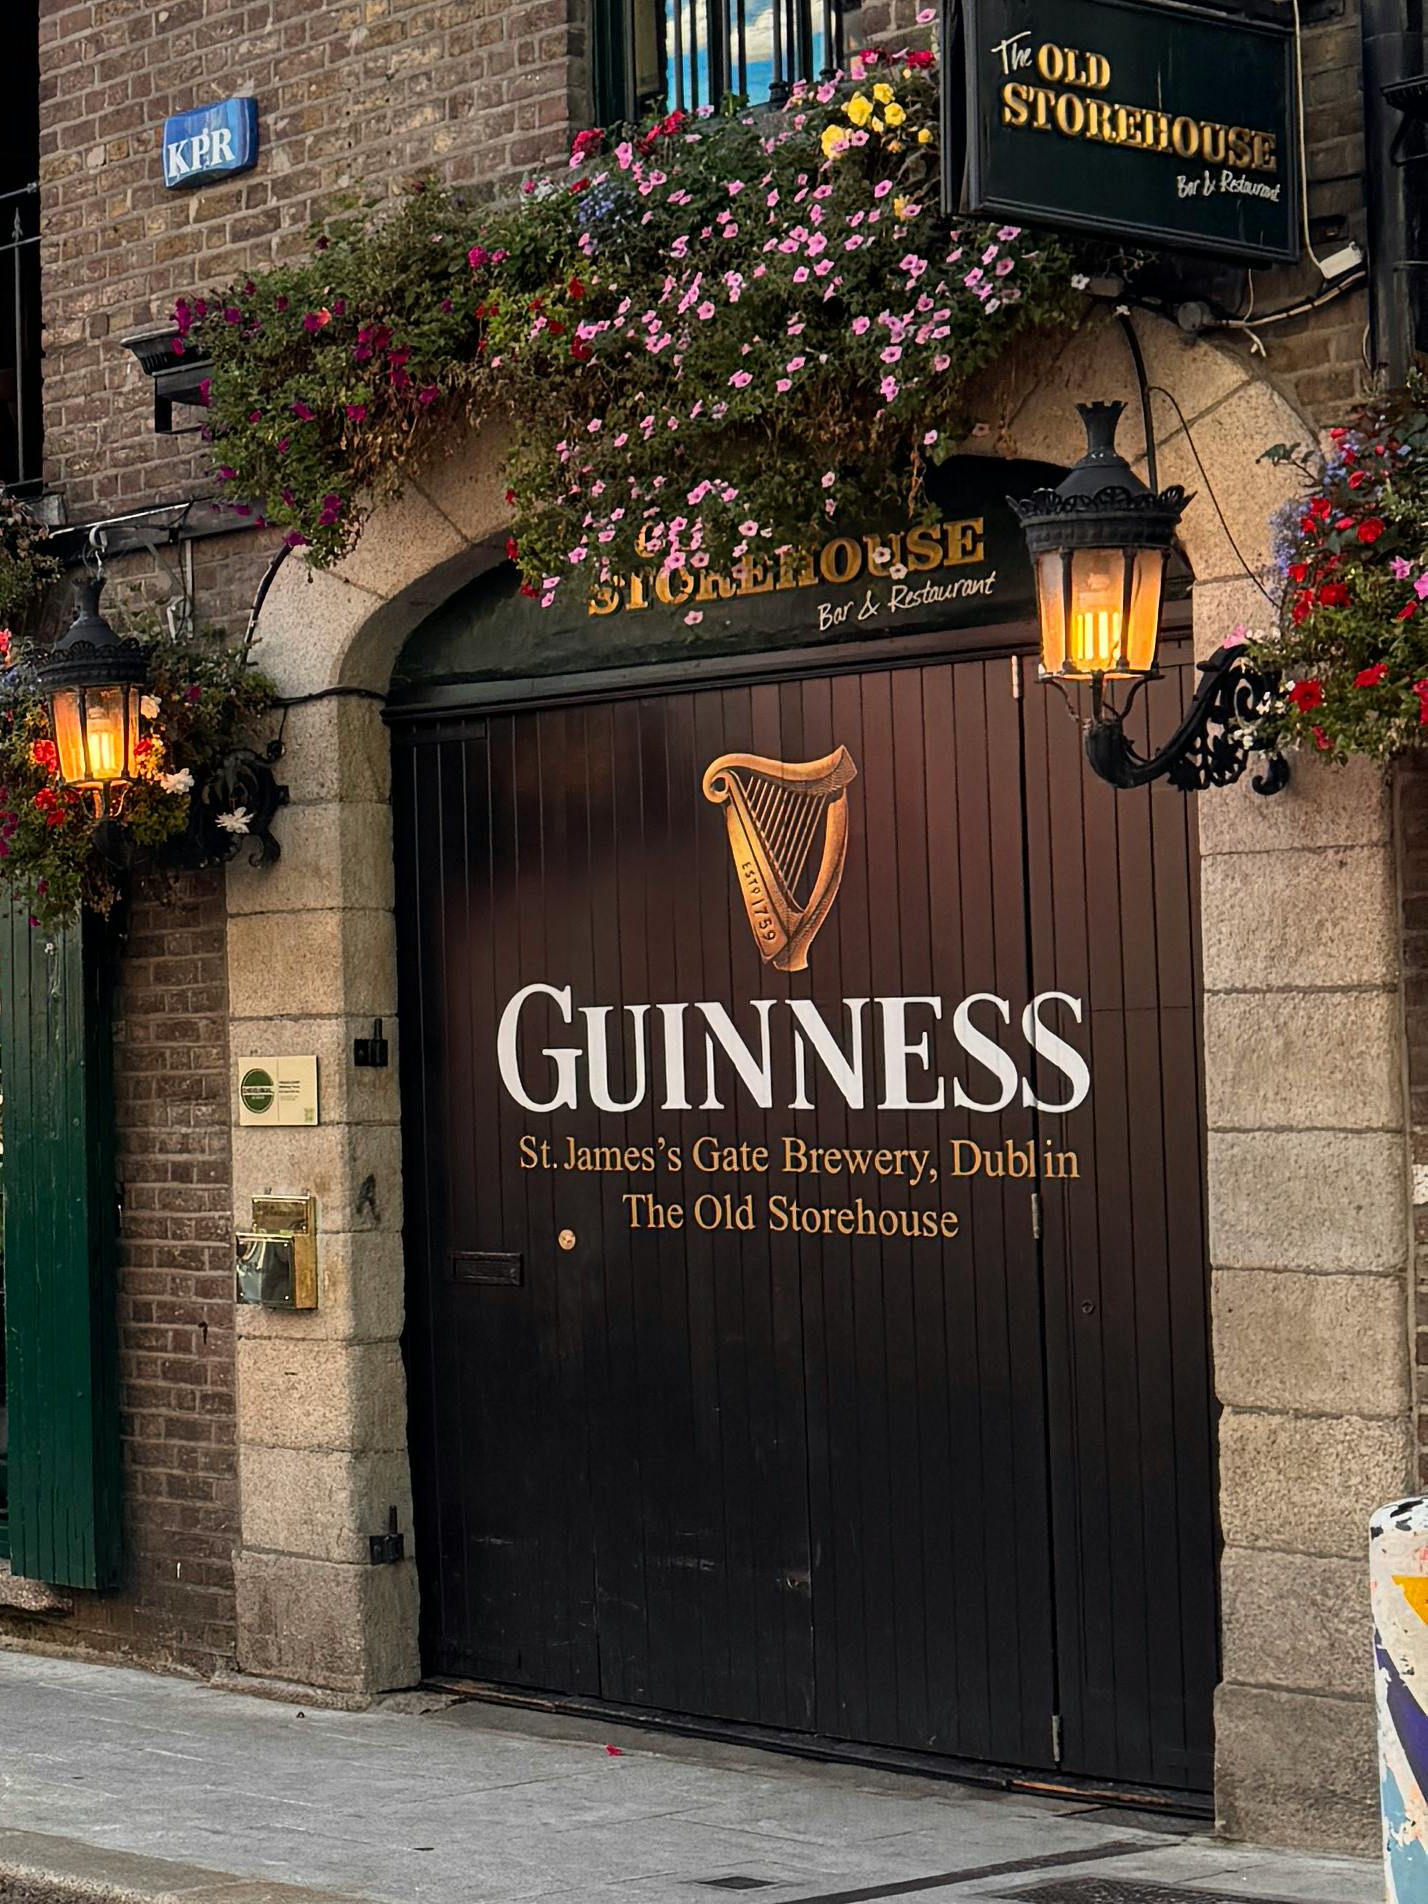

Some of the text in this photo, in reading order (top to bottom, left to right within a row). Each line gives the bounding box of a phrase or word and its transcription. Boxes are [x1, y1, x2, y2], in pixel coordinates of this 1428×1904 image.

[991, 31, 1111, 91] The OLD
[167, 127, 236, 178] KPR
[1001, 81, 1278, 173] STOREHOUSE
[1176, 169, 1282, 203] Bar & Restaurant
[817, 571, 998, 631] Bar & Restaurant
[751, 898, 777, 941] 1759
[496, 982, 1092, 1114] GUINNESS
[692, 1136, 770, 1173] Gate
[781, 1137, 938, 1187] Brewery,
[949, 1139, 1081, 1179] Dublin
[623, 1193, 960, 1239] The Old Storehouse
